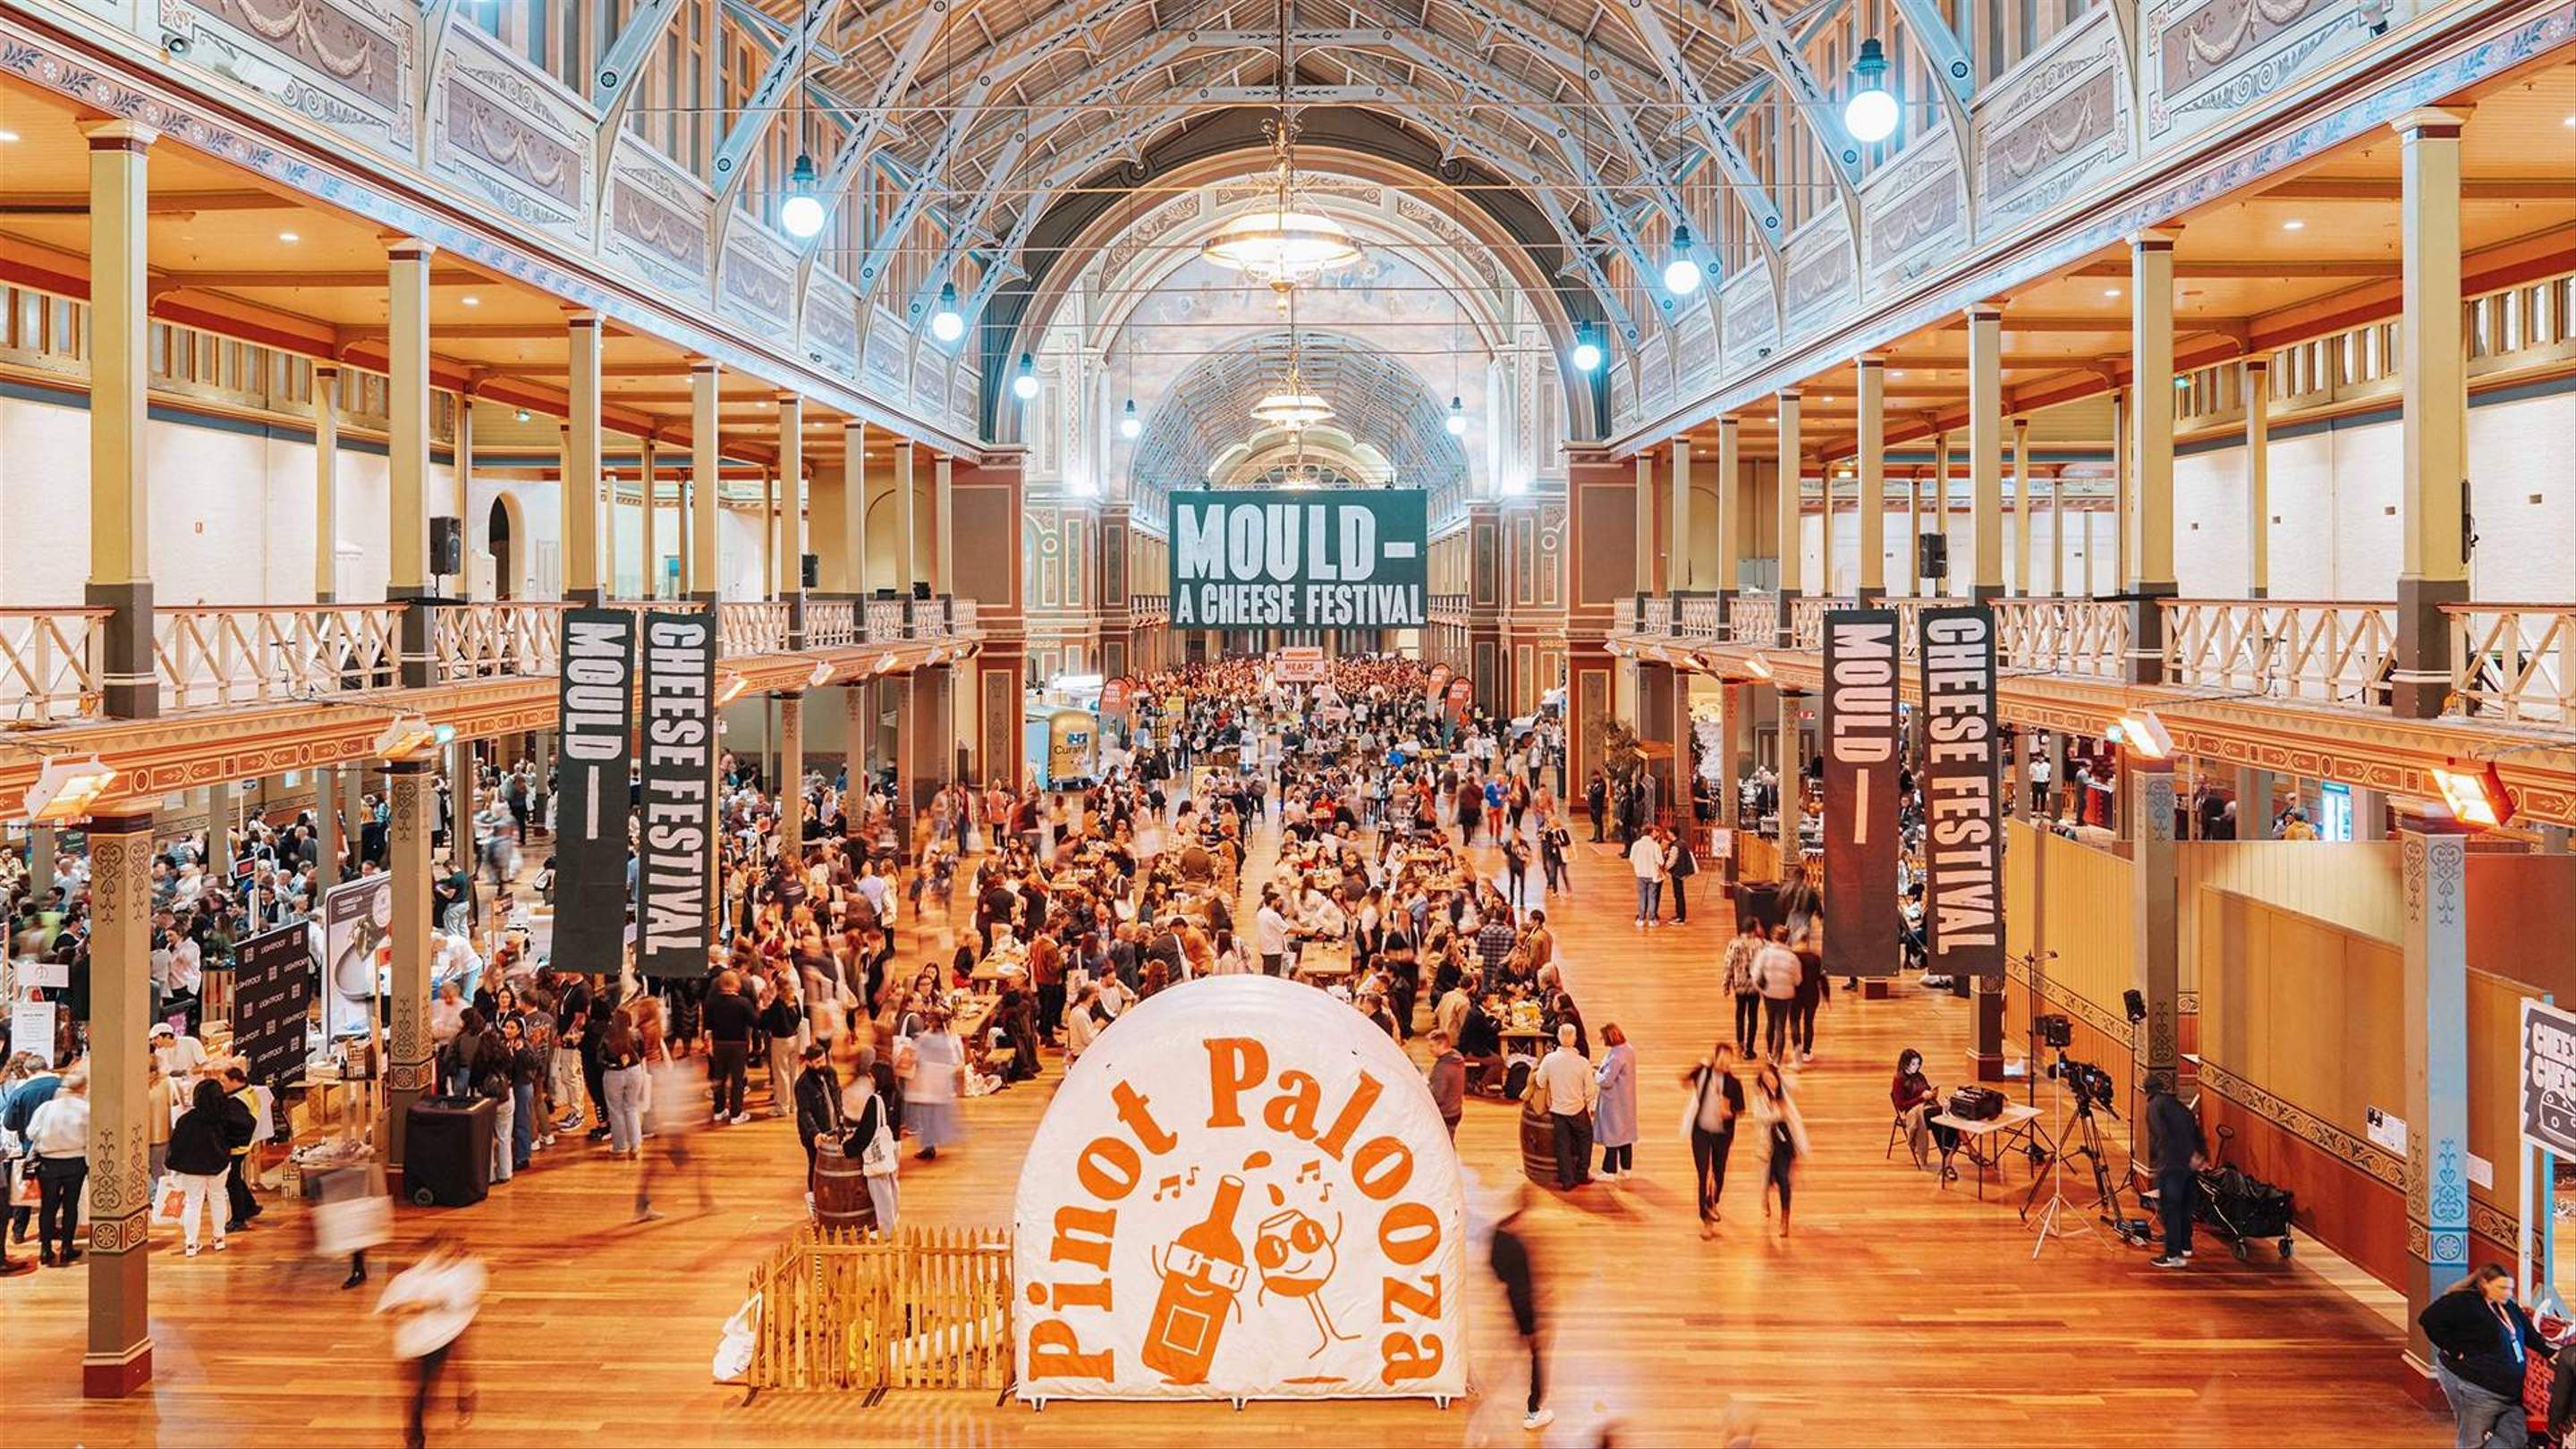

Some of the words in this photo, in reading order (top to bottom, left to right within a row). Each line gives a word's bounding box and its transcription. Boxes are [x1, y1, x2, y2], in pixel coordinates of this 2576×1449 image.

[1176, 584, 1194, 623] A
[1201, 583, 1295, 623] CHEESE
[1306, 584, 1424, 625] FESTIVAL
[649, 622, 707, 767] CHEESE
[1927, 617, 1988, 765] CHEESE
[645, 779, 706, 955] FESTIVAL
[1931, 776, 1996, 955] FESTIVAL
[1027, 1079, 1179, 1384] Pinot
[1202, 1037, 1444, 1386] Palooza
